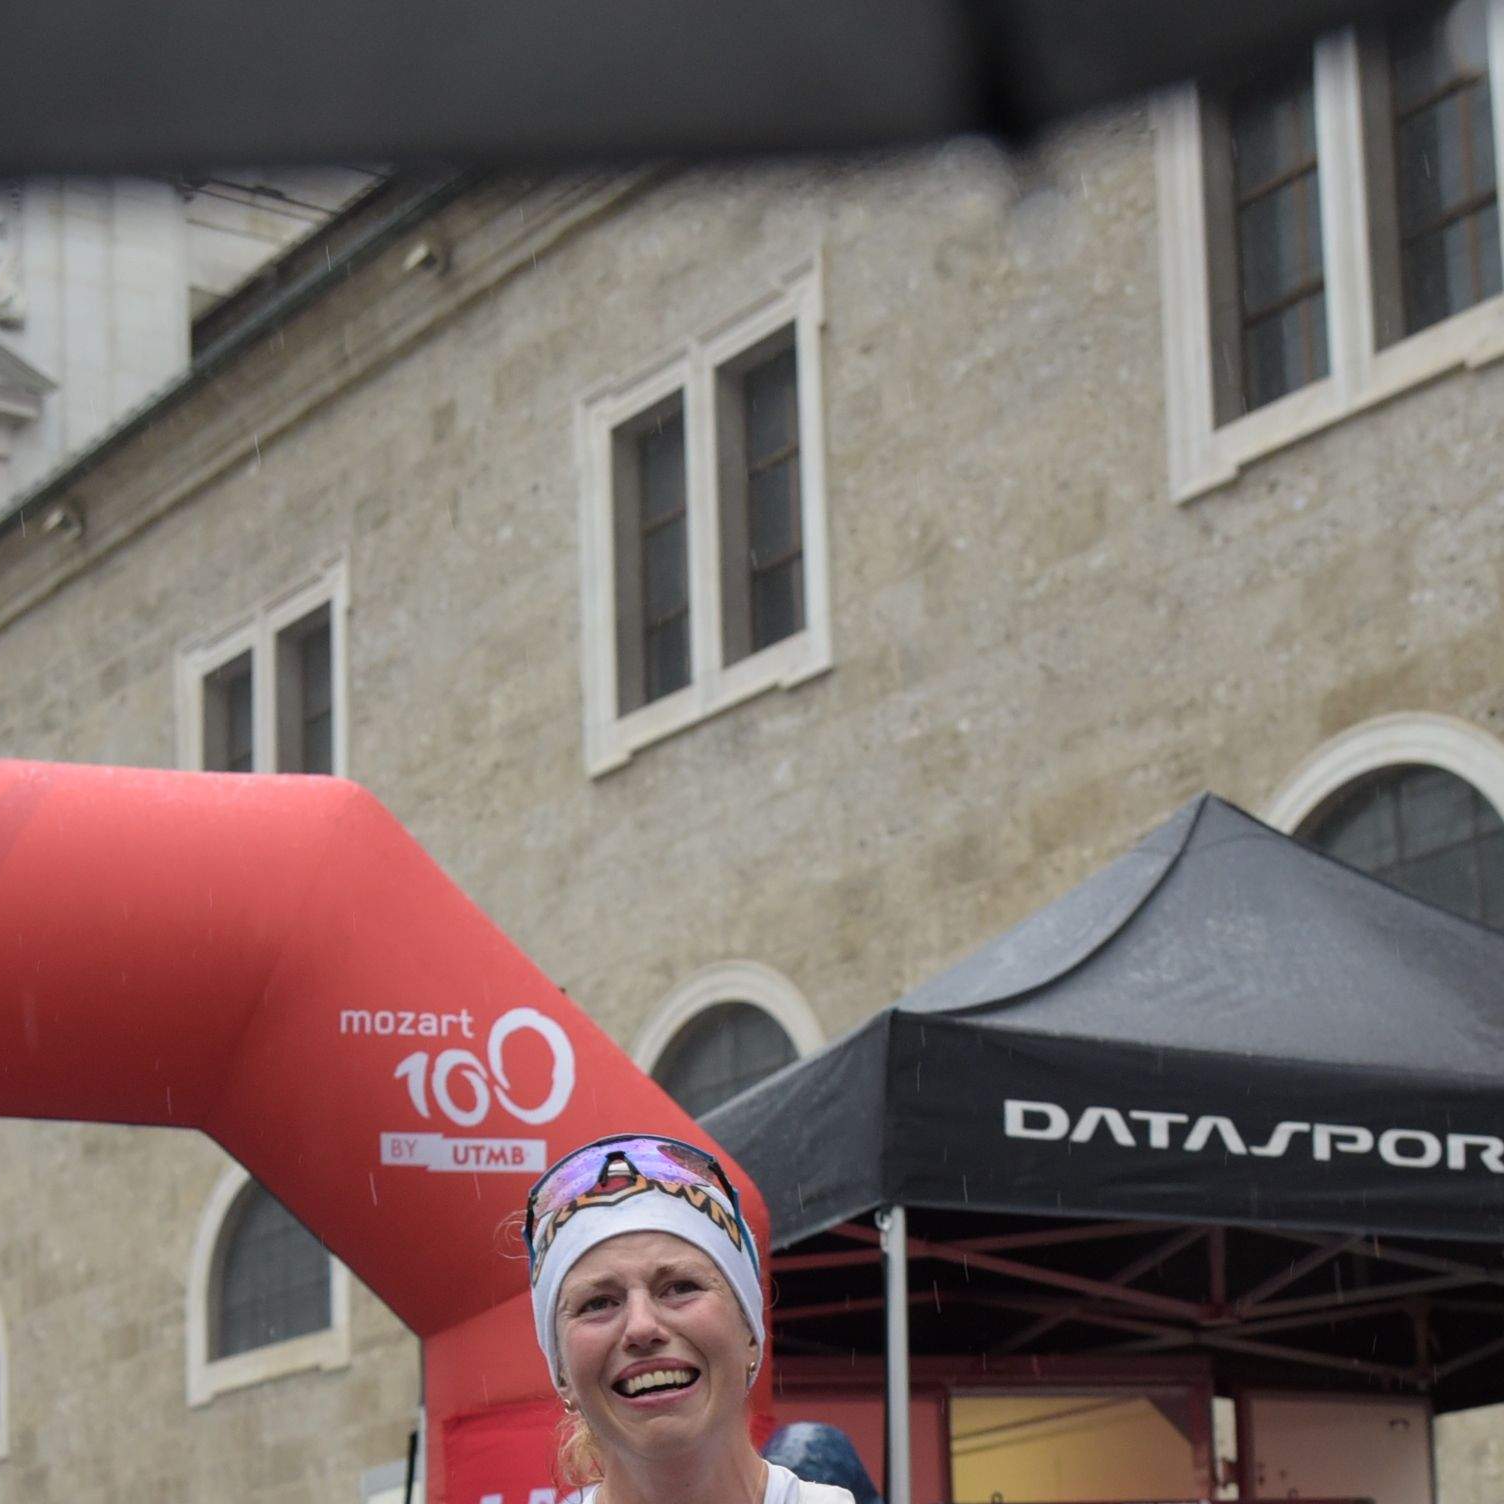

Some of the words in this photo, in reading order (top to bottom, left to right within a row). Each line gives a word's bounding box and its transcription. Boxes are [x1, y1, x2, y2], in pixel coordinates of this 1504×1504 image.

[340, 1009, 474, 1039] mozart
[393, 1007, 575, 1127] 100
[390, 1139, 418, 1159] BY
[452, 1145, 524, 1166] UTMB
